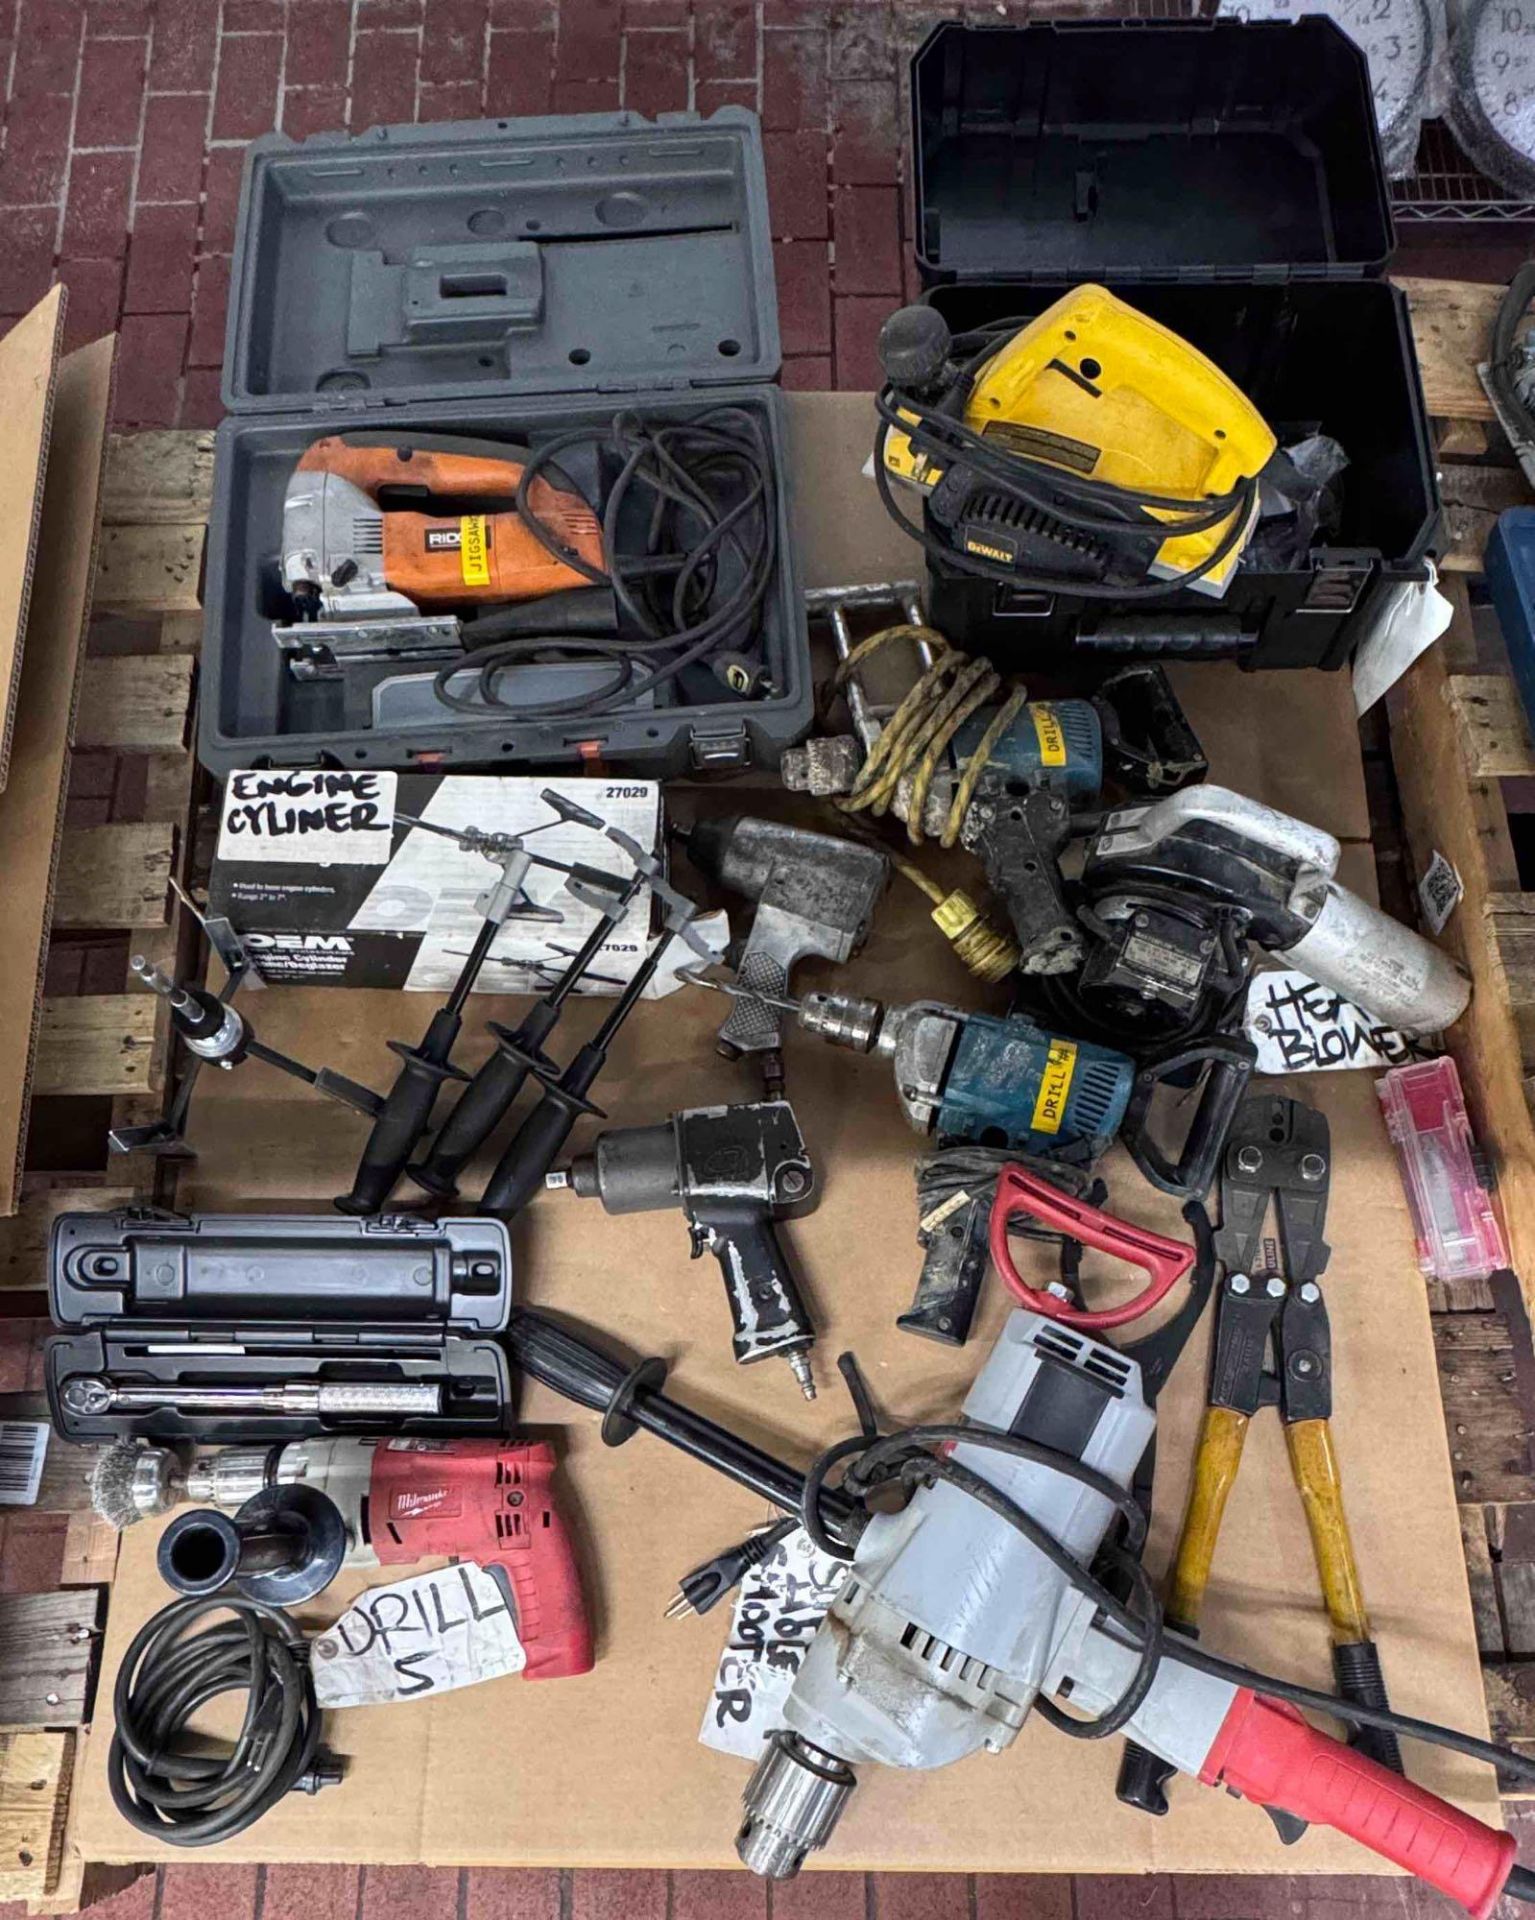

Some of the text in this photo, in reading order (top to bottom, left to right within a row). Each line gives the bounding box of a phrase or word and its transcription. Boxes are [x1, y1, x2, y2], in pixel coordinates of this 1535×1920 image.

[1501, 8, 1522, 33] 10
[1384, 36, 1401, 60] 3
[1492, 50, 1510, 76] 9
[1504, 90, 1519, 116] 8
[232, 772, 381, 800] ENGINE
[605, 786, 648, 799] 27029
[227, 801, 390, 837] CYLINER
[241, 933, 352, 951] OEM
[1265, 980, 1371, 1030] HEA
[1042, 1071, 1066, 1119] DRILL
[337, 1567, 507, 1656] DRILL
